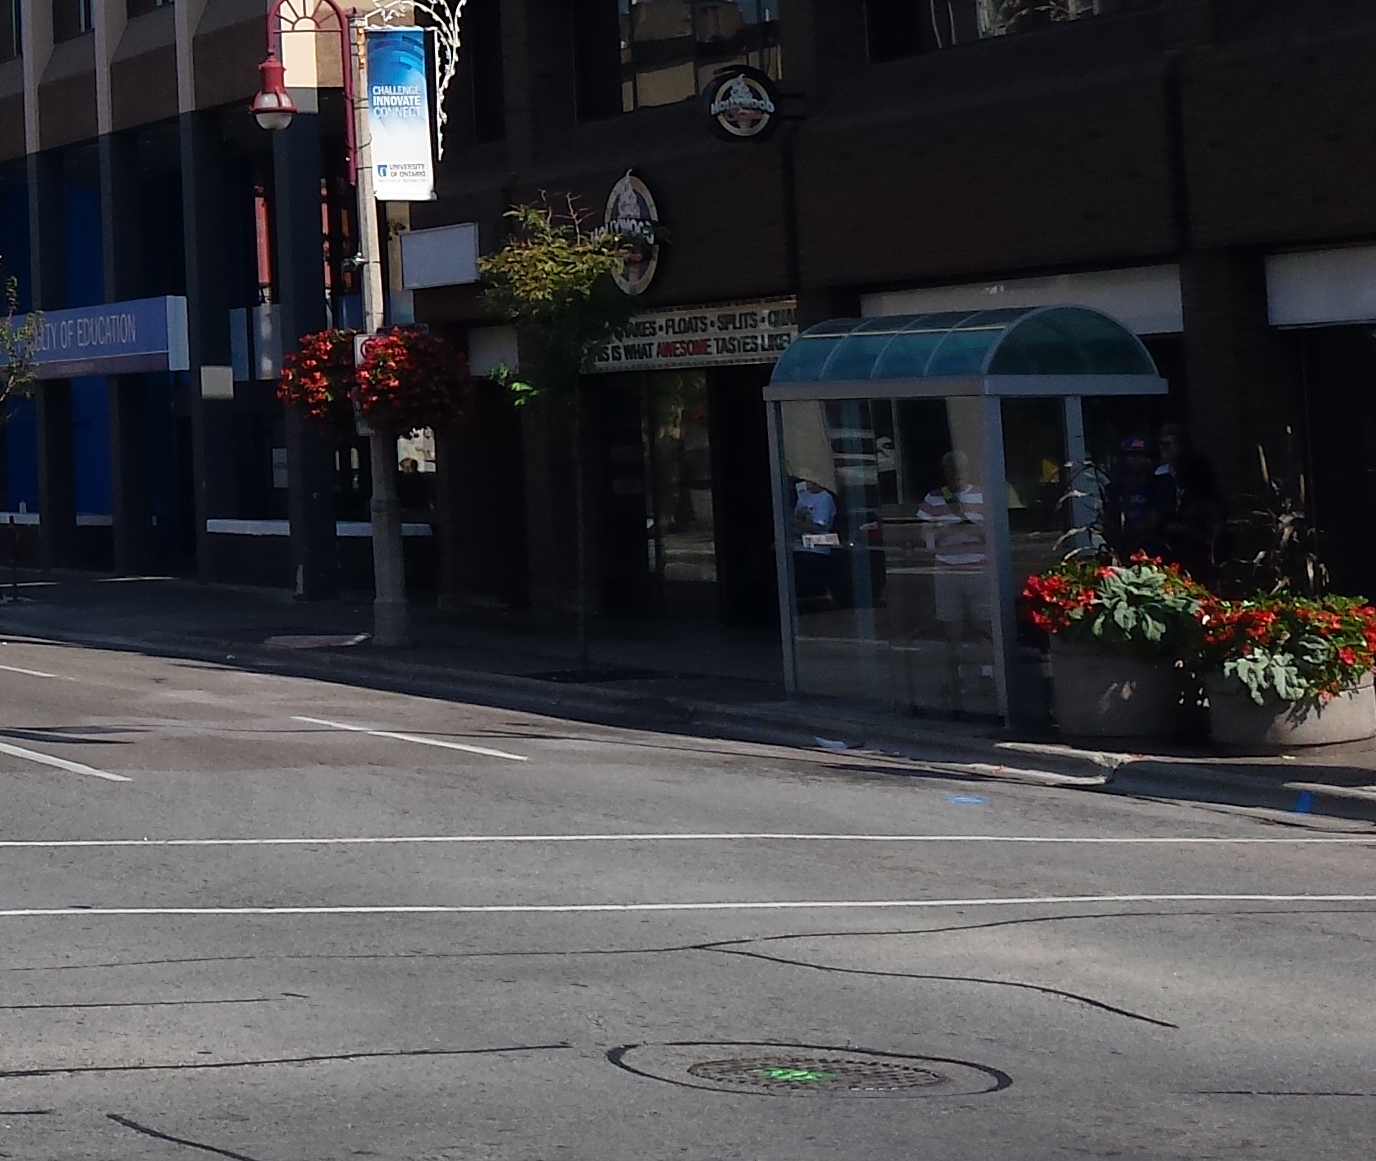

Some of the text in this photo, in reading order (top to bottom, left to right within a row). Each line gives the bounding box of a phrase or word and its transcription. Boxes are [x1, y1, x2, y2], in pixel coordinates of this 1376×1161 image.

[372, 84, 421, 95] CHALLENGE
[373, 95, 421, 106] INNOVATE
[373, 106, 421, 118] CONNECT
[389, 163, 426, 171] UNIVERSITY
[390, 170, 426, 178] OF ONTARIO
[665, 315, 707, 336] FLOATS
[717, 311, 756, 331] SPLITS
[59, 319, 74, 349] OF
[77, 314, 136, 348] EDUCATION
[611, 345, 622, 362] IS
[623, 342, 654, 361] WHAT
[656, 337, 712, 359] AWESOME
[715, 335, 758, 355] TASTES
